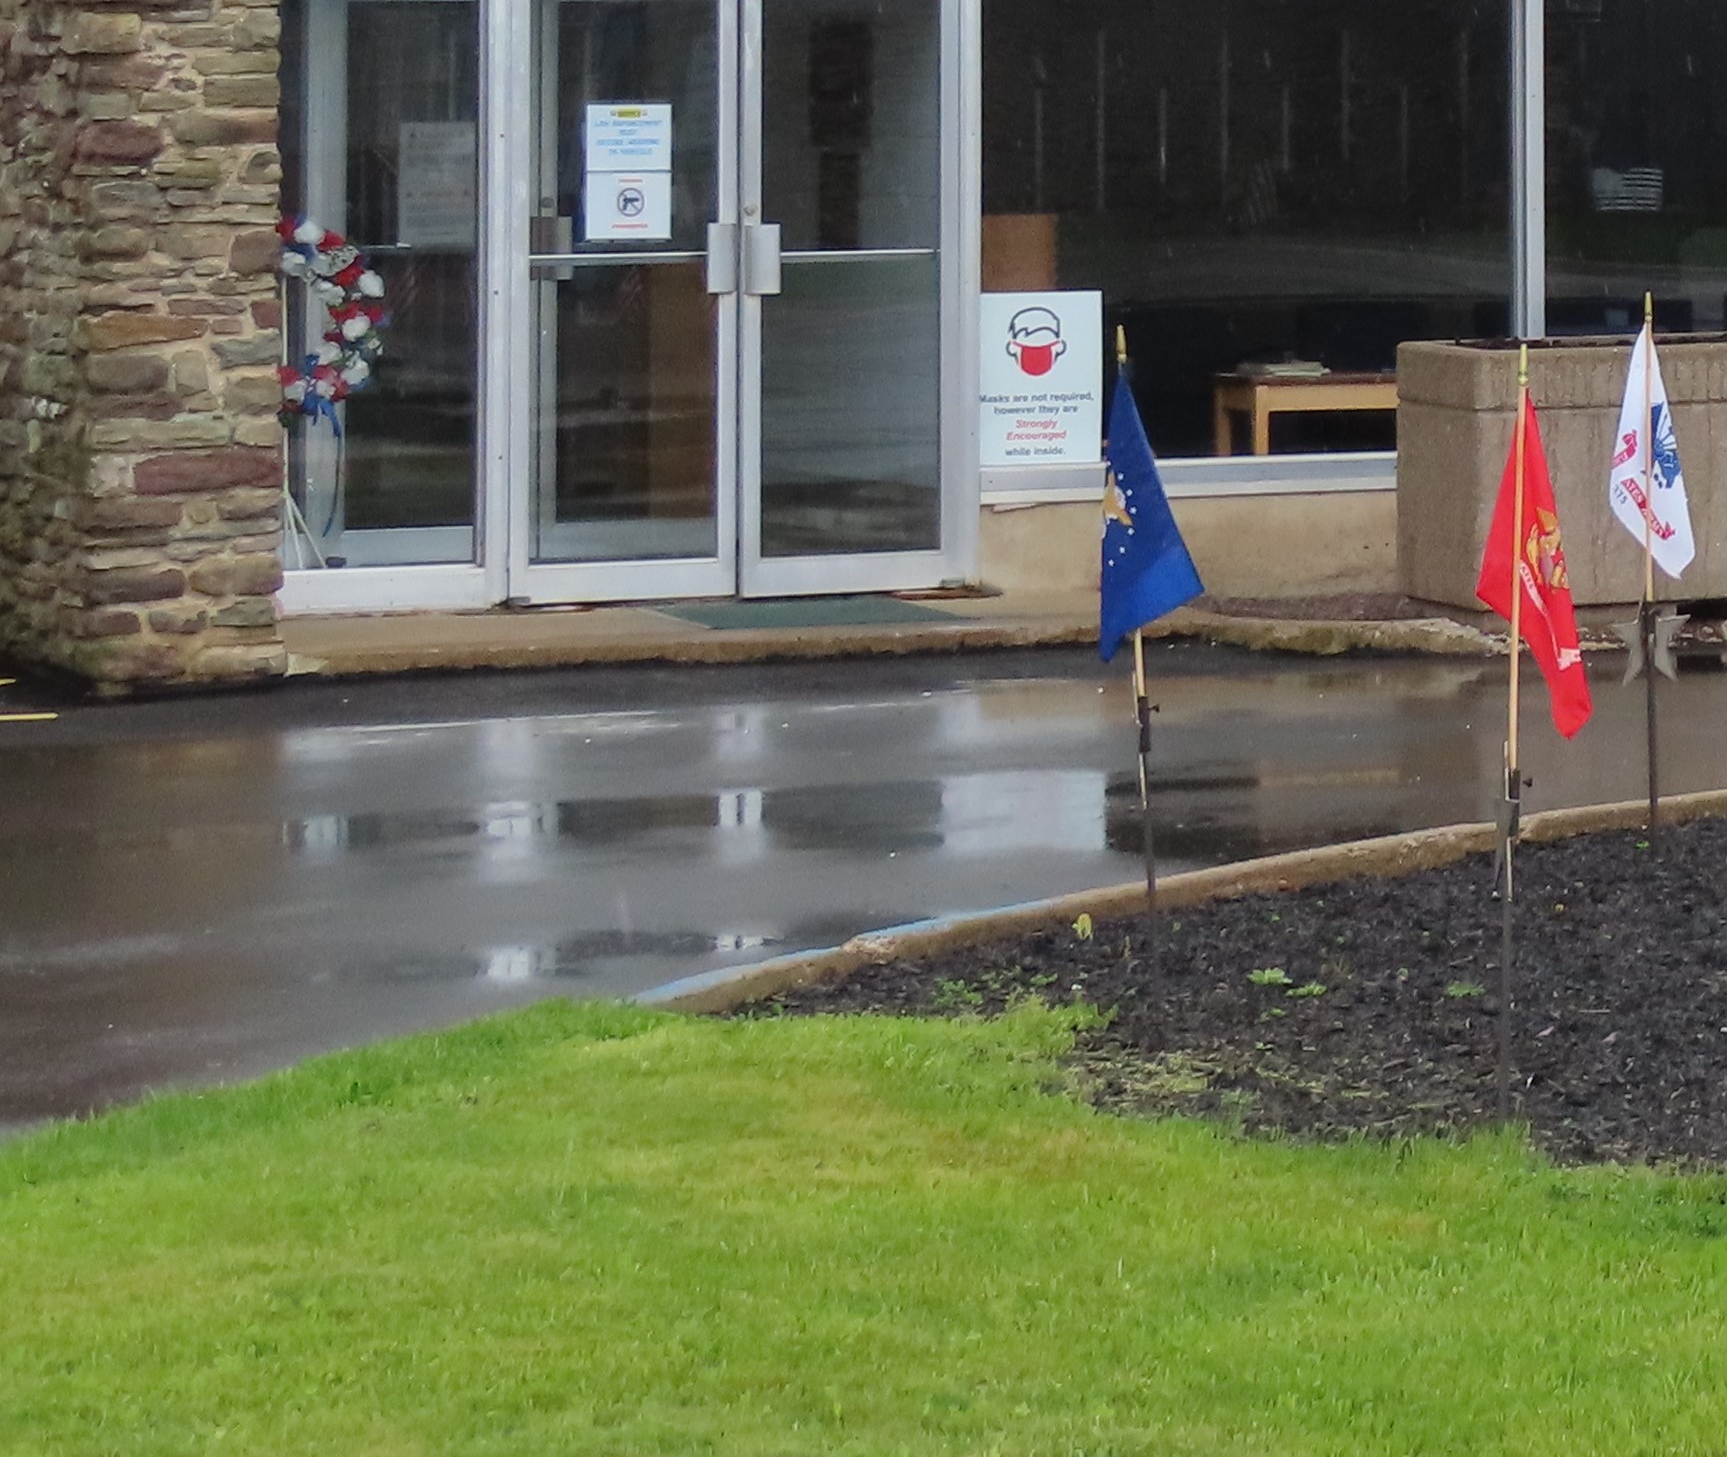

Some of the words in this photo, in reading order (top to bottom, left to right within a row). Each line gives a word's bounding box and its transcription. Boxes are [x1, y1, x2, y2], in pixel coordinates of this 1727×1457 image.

[979, 394, 1010, 403] Masks
[1013, 395, 1028, 403] are
[1031, 393, 1048, 402] not
[994, 406, 1036, 415] however
[1038, 405, 1060, 416] they
[1062, 405, 1079, 413] are
[1016, 419, 1059, 430] Strongly
[1006, 430, 1068, 441] Encouraged
[1005, 447, 1031, 456] while
